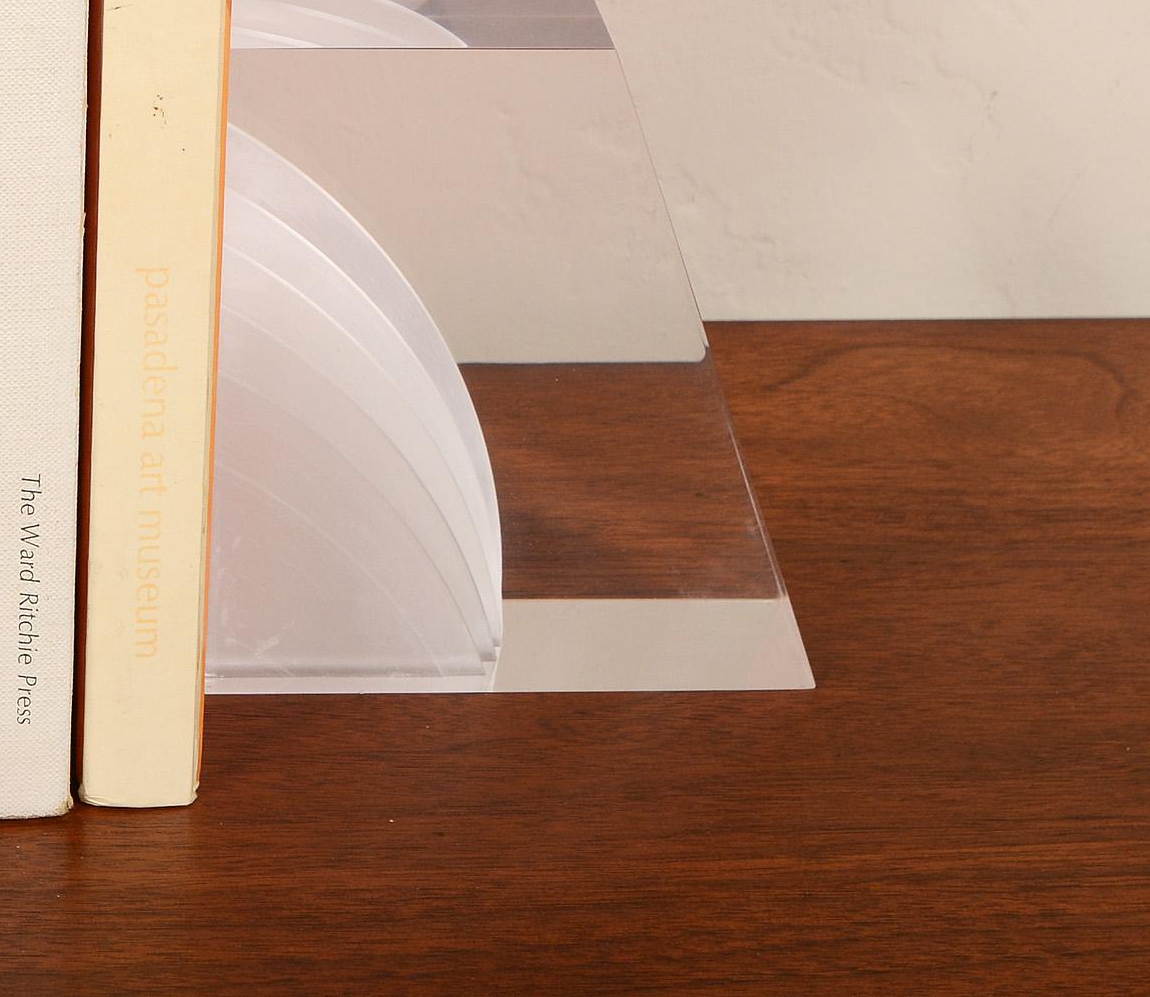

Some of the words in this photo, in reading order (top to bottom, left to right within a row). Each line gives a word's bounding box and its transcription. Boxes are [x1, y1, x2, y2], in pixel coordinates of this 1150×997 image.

[136, 266, 178, 439] pasadena
[20, 473, 42, 516] The
[142, 454, 167, 504] art
[19, 522, 41, 584] Ward
[135, 510, 165, 659] museum
[18, 592, 40, 666] Ritchie
[16, 673, 38, 726] Press
